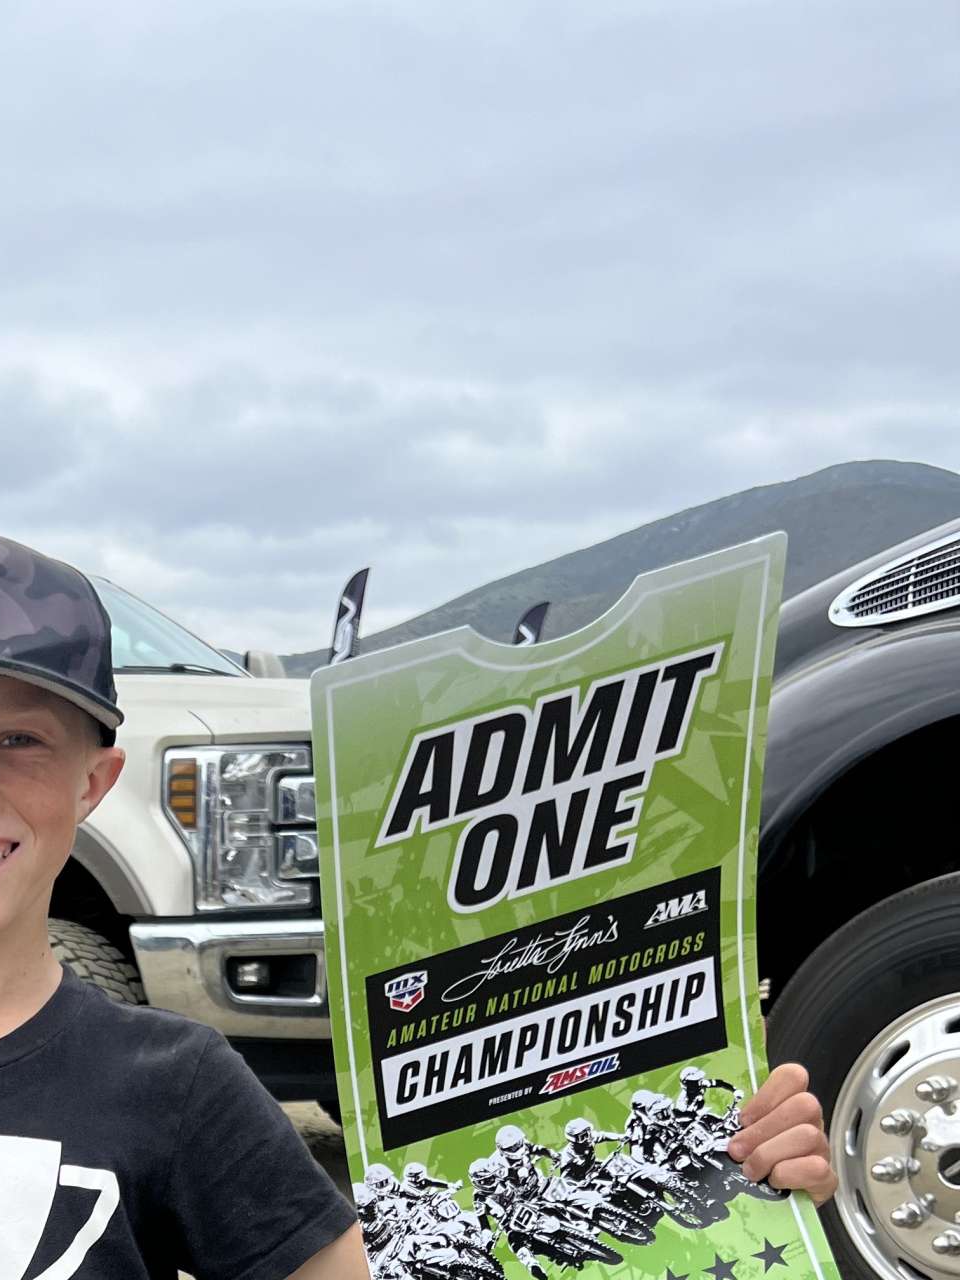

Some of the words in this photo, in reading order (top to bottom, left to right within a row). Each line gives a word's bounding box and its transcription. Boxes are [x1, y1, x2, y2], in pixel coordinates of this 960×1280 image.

[385, 651, 716, 839] ADMIT
[452, 771, 646, 907] ONE
[643, 889, 709, 927] AMA
[387, 1003, 476, 1048] AMATEUR
[486, 977, 579, 1018] NATIONAL
[588, 931, 706, 986] MOTOCROSS
[395, 971, 707, 1105] CHAMPIONSHIP
[488, 1089, 523, 1106] PRESENTED
[523, 1087, 533, 1096] BY
[542, 1055, 620, 1093] AMSOIL
